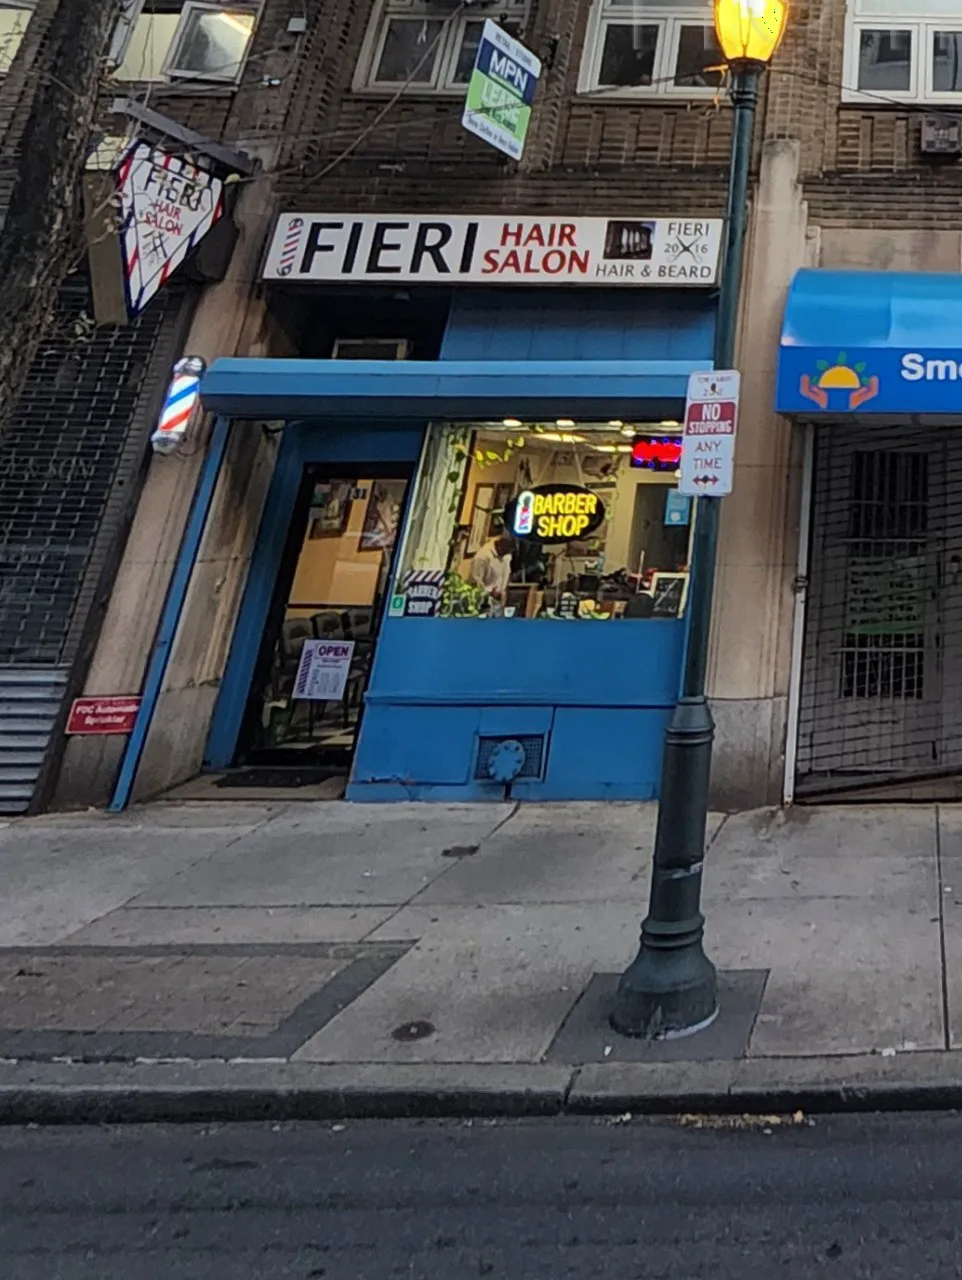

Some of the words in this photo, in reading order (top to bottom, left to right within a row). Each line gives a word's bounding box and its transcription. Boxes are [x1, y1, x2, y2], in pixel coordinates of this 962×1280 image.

[488, 48, 529, 93] MPN
[152, 198, 181, 220] HAIR
[145, 211, 184, 236] SALON
[667, 222, 709, 237] FIERI
[499, 223, 577, 247] HAIR
[299, 222, 479, 274] FIERI
[663, 243, 679, 254] 20
[480, 249, 590, 275] SALON
[595, 263, 634, 278] HAIR
[640, 264, 652, 278] &
[657, 264, 712, 279] BEARD
[701, 403, 721, 421] NO
[688, 421, 732, 434] STOPPING
[694, 440, 722, 453] ANY
[692, 457, 722, 470] TIME
[534, 492, 598, 515] BARBER
[537, 515, 589, 537] SHOP
[318, 645, 349, 656] OPEN
